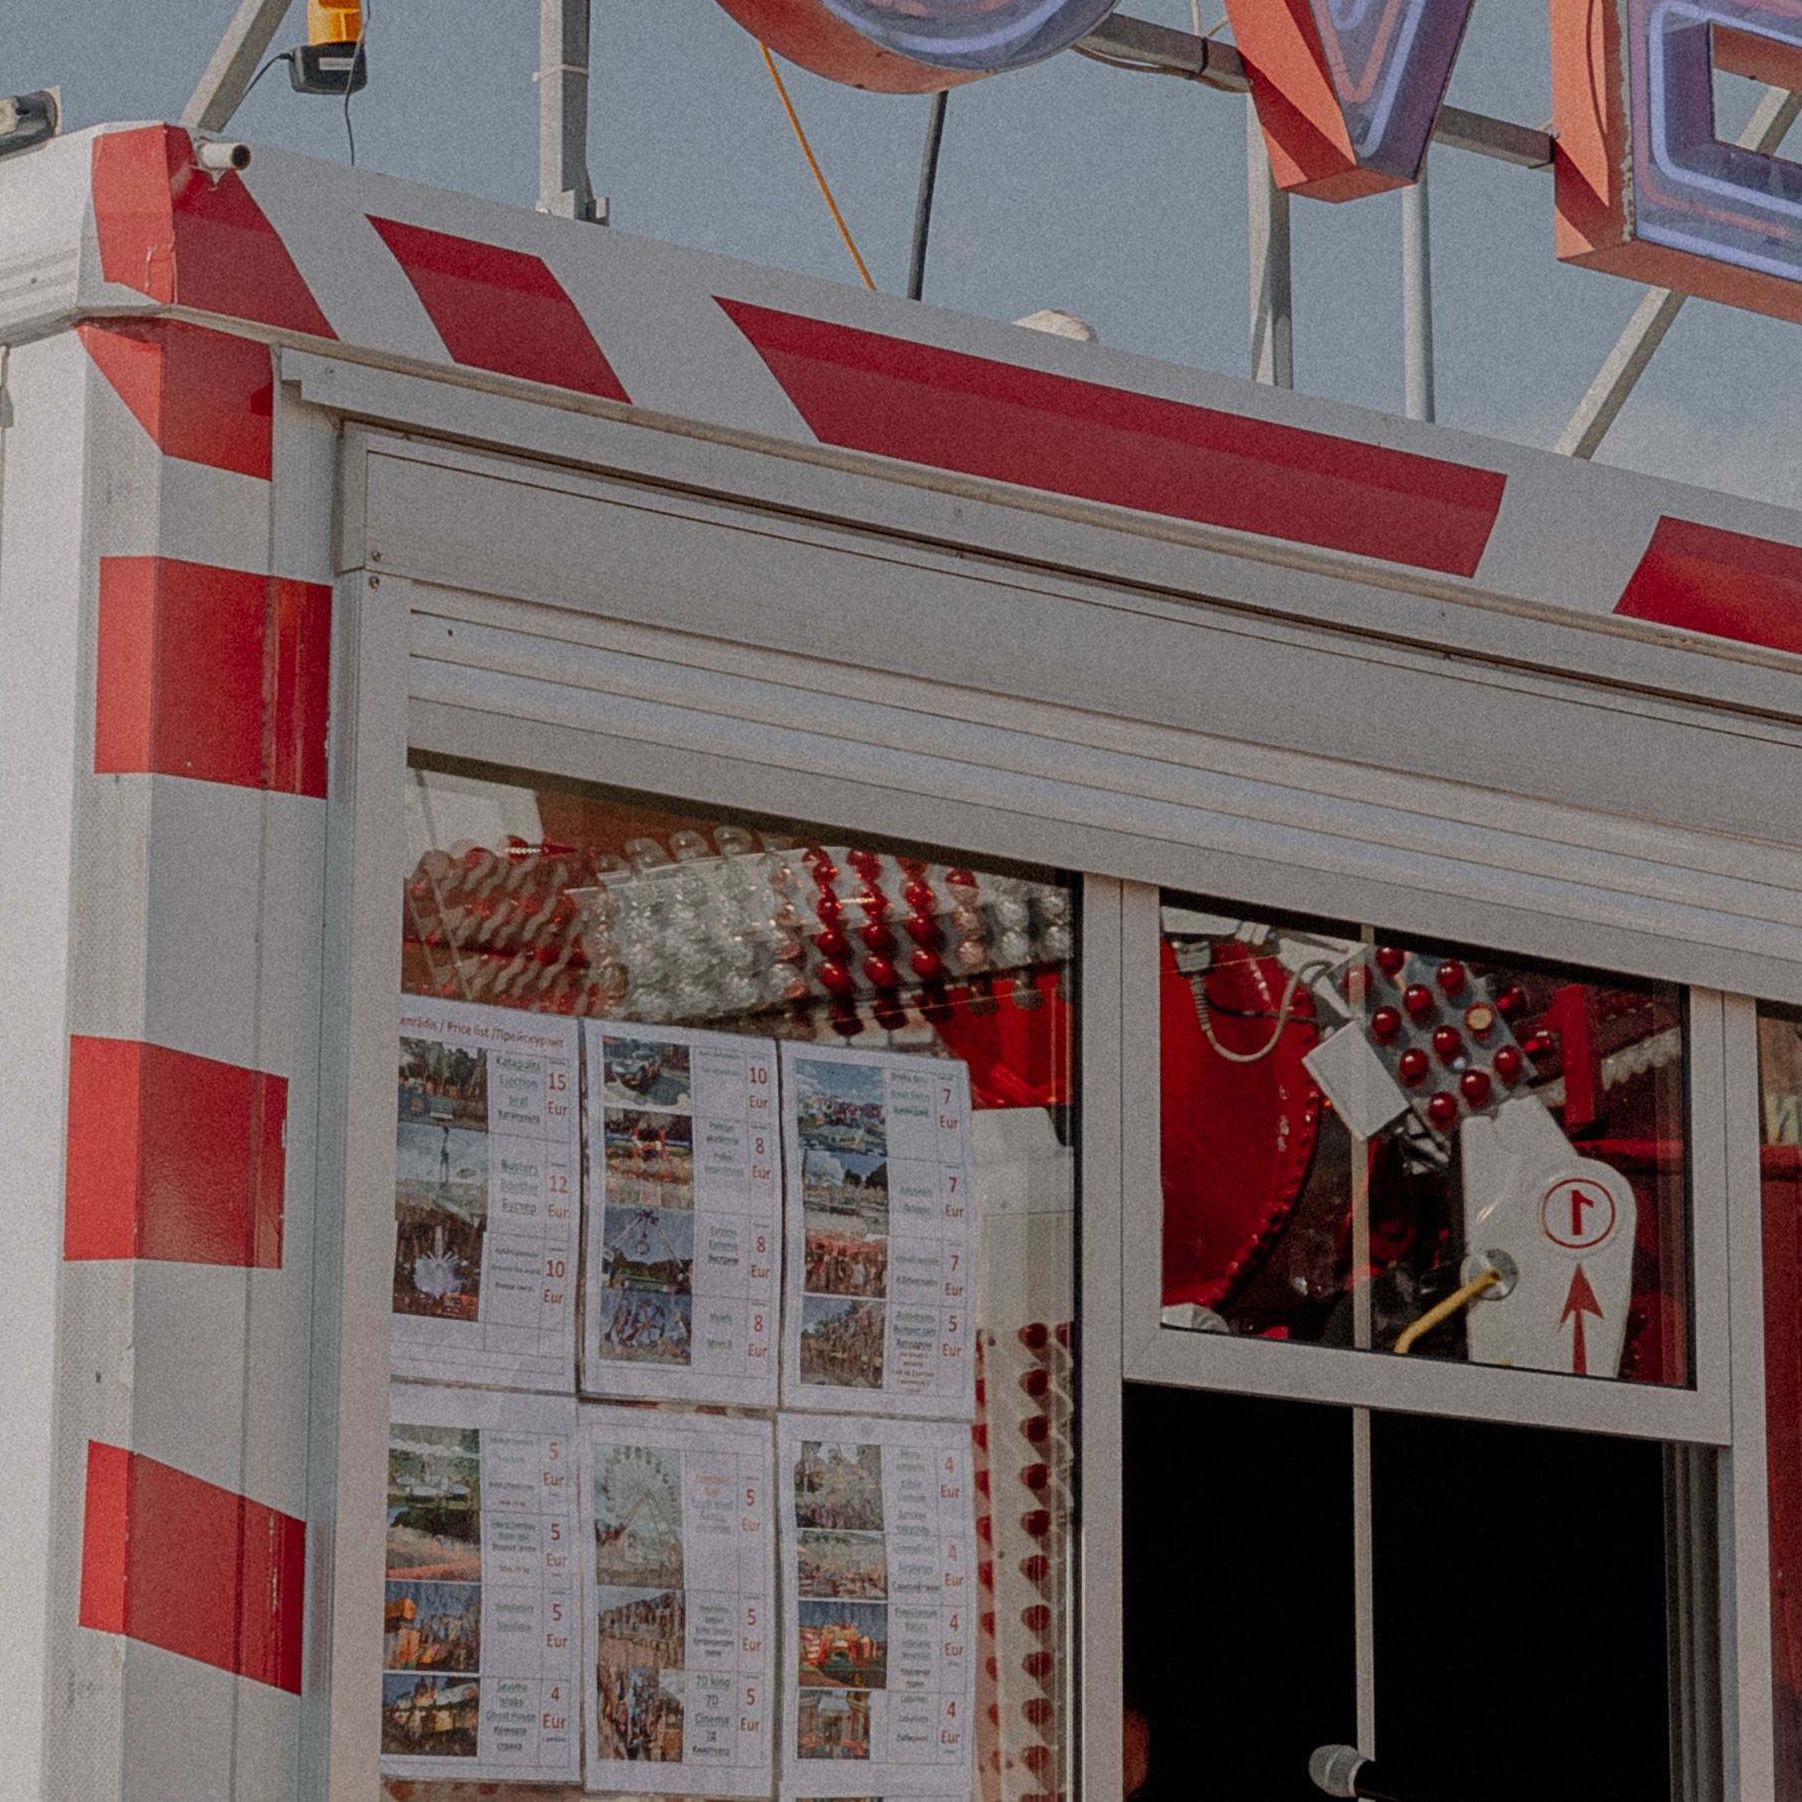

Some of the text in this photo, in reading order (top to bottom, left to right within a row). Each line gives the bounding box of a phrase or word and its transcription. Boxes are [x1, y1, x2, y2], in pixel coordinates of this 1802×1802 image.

[447, 1021, 471, 1036] Price
[474, 1025, 490, 1038] list
[548, 1073, 567, 1092] 15
[750, 1068, 767, 1084] 10
[749, 1095, 768, 1109] Eur
[943, 1088, 951, 1104] 7
[547, 1101, 568, 1116] Eur
[940, 1115, 958, 1129] Eur
[755, 1137, 764, 1154] 8
[752, 1166, 771, 1180] Eur
[549, 1174, 568, 1194] 12
[949, 1177, 957, 1193] 7
[548, 1204, 569, 1219] Eur
[945, 1205, 964, 1218] Eur
[757, 1236, 766, 1253] 8
[546, 1260, 565, 1278] 10
[951, 1254, 959, 1271] 7
[751, 1265, 771, 1279] Eur
[543, 1289, 564, 1304] Eur
[945, 1283, 964, 1297] Eur
[754, 1314, 763, 1332] 8
[949, 1315, 958, 1332] 5
[748, 1344, 768, 1358] Eur
[942, 1343, 962, 1357] Eur
[549, 1442, 558, 1461] 5
[945, 1457, 954, 1474] 4
[543, 1472, 565, 1486] Eur
[746, 1488, 755, 1506] 5
[940, 1484, 960, 1498] Eur
[551, 1523, 561, 1541] 5
[742, 1517, 761, 1532] Eur
[546, 1553, 568, 1567] Eur
[948, 1545, 957, 1562] 4
[945, 1572, 964, 1586] Eur
[552, 1604, 562, 1621] 5
[748, 1608, 756, 1625] 5
[950, 1614, 959, 1631] 4
[546, 1634, 568, 1648] Eur
[742, 1637, 762, 1651] Eur
[945, 1643, 964, 1656] Eur
[551, 1687, 559, 1702] 4
[746, 1688, 755, 1706] 5
[946, 1702, 956, 1718] 4
[542, 1714, 567, 1730] Eur
[740, 1717, 760, 1731] Eur
[941, 1730, 960, 1744] Eur
